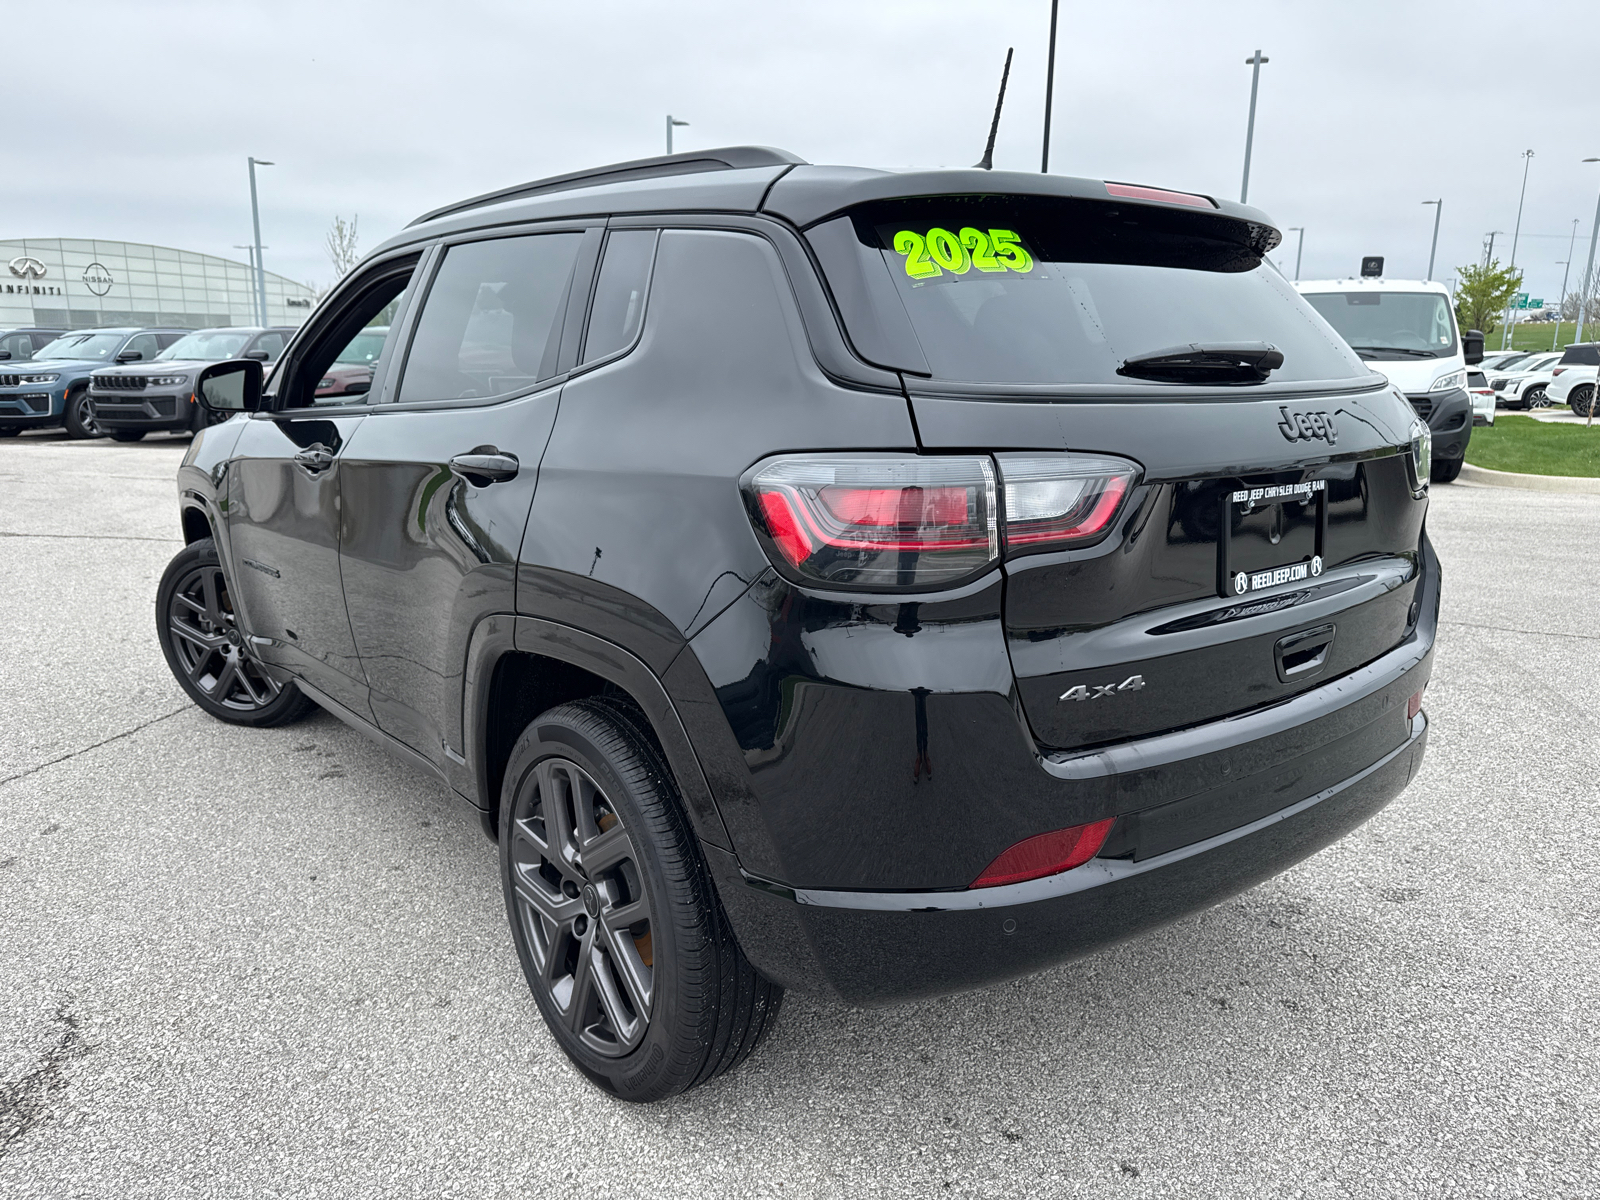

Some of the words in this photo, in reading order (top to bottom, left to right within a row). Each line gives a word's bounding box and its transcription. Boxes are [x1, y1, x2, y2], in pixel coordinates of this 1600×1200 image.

[893, 227, 1034, 280] 2025
[82, 275, 114, 284] NISSAN
[1278, 405, 1338, 447] Jeep
[1232, 490, 1249, 503] REED
[1249, 488, 1264, 500] JEEP
[1264, 484, 1293, 498] CHRYSLER
[1293, 482, 1312, 494] DODGE
[1312, 480, 1325, 491] RAM
[1251, 564, 1308, 590] REEDJEEP.COM
[1059, 674, 1146, 702] 4x4
